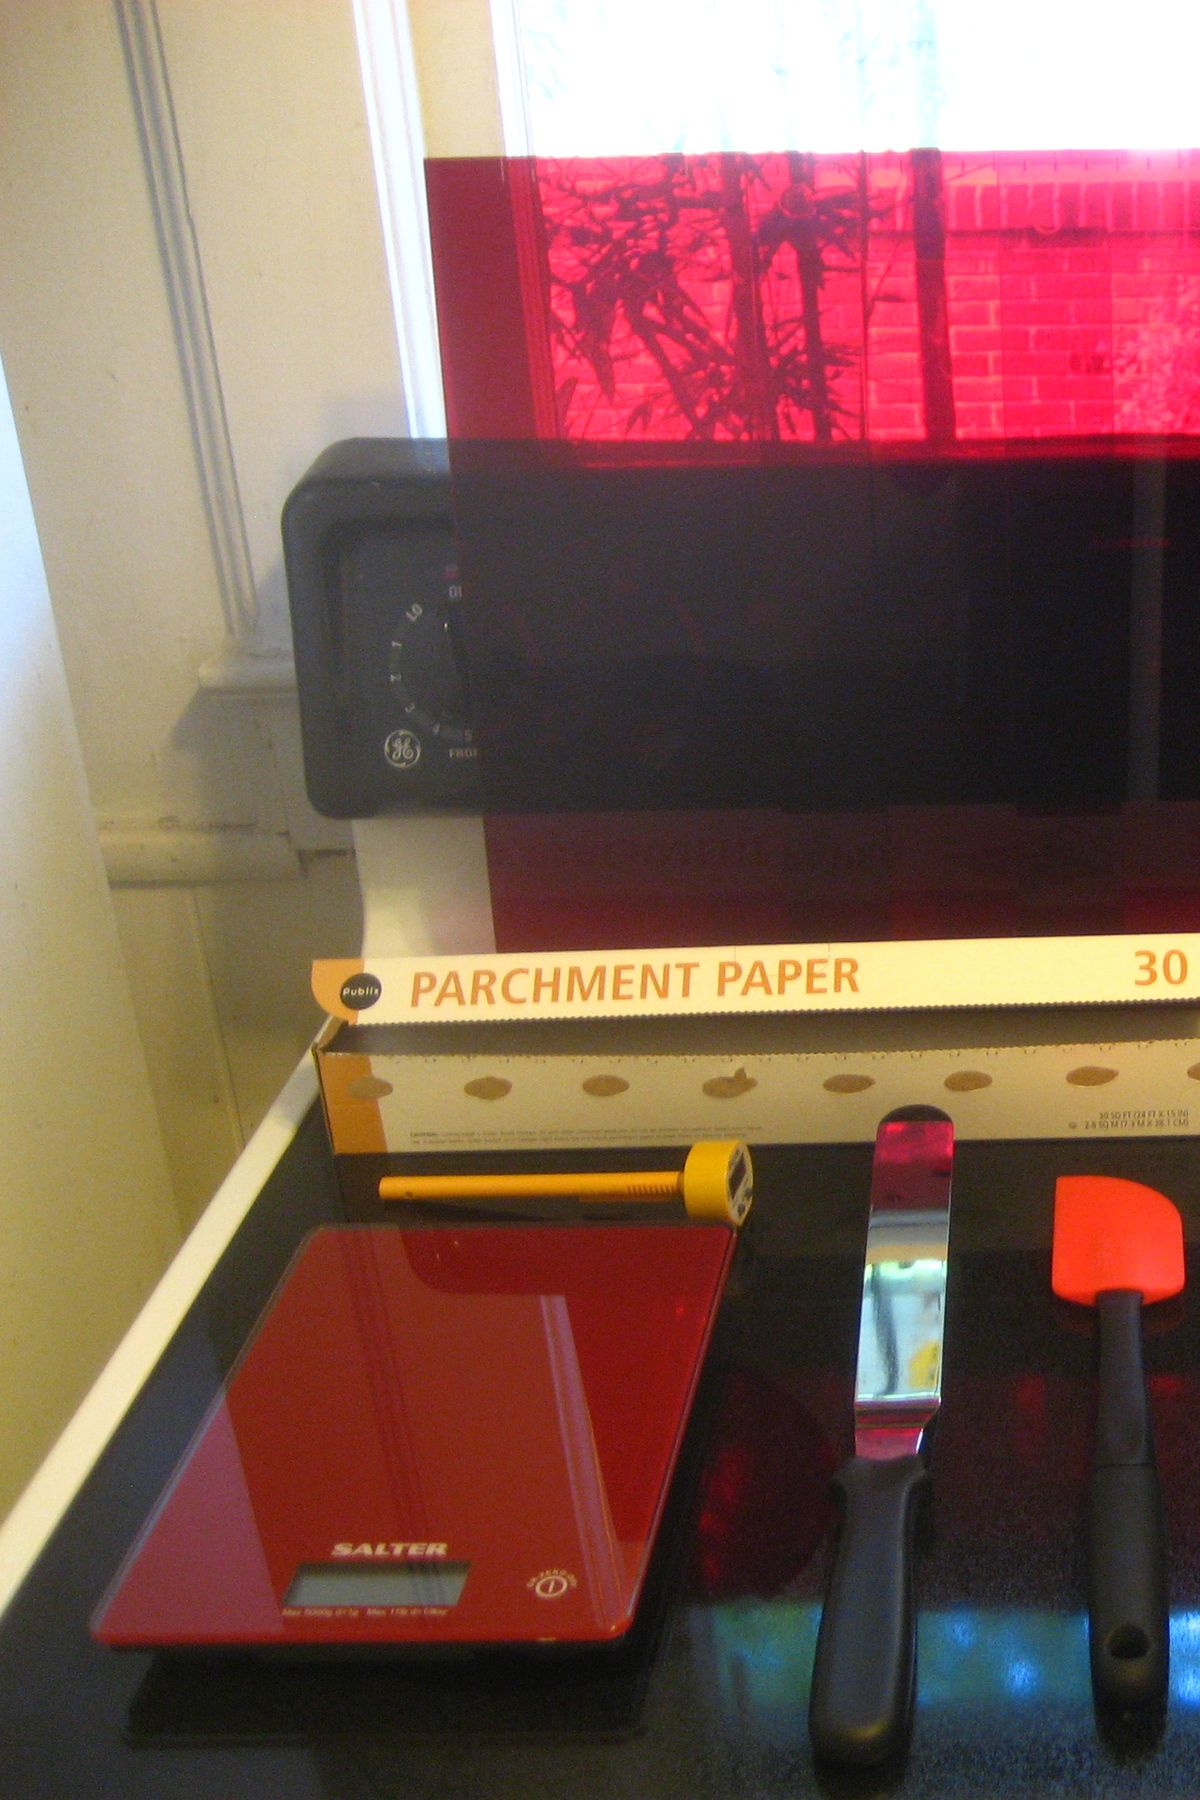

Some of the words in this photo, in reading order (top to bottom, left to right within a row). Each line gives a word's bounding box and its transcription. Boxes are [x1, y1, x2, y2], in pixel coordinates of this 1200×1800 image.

[410, 961, 700, 1008] PARCHMENT
[716, 956, 861, 997] PAPER
[1133, 948, 1189, 987] 30
[331, 1541, 448, 1557] SALTER
